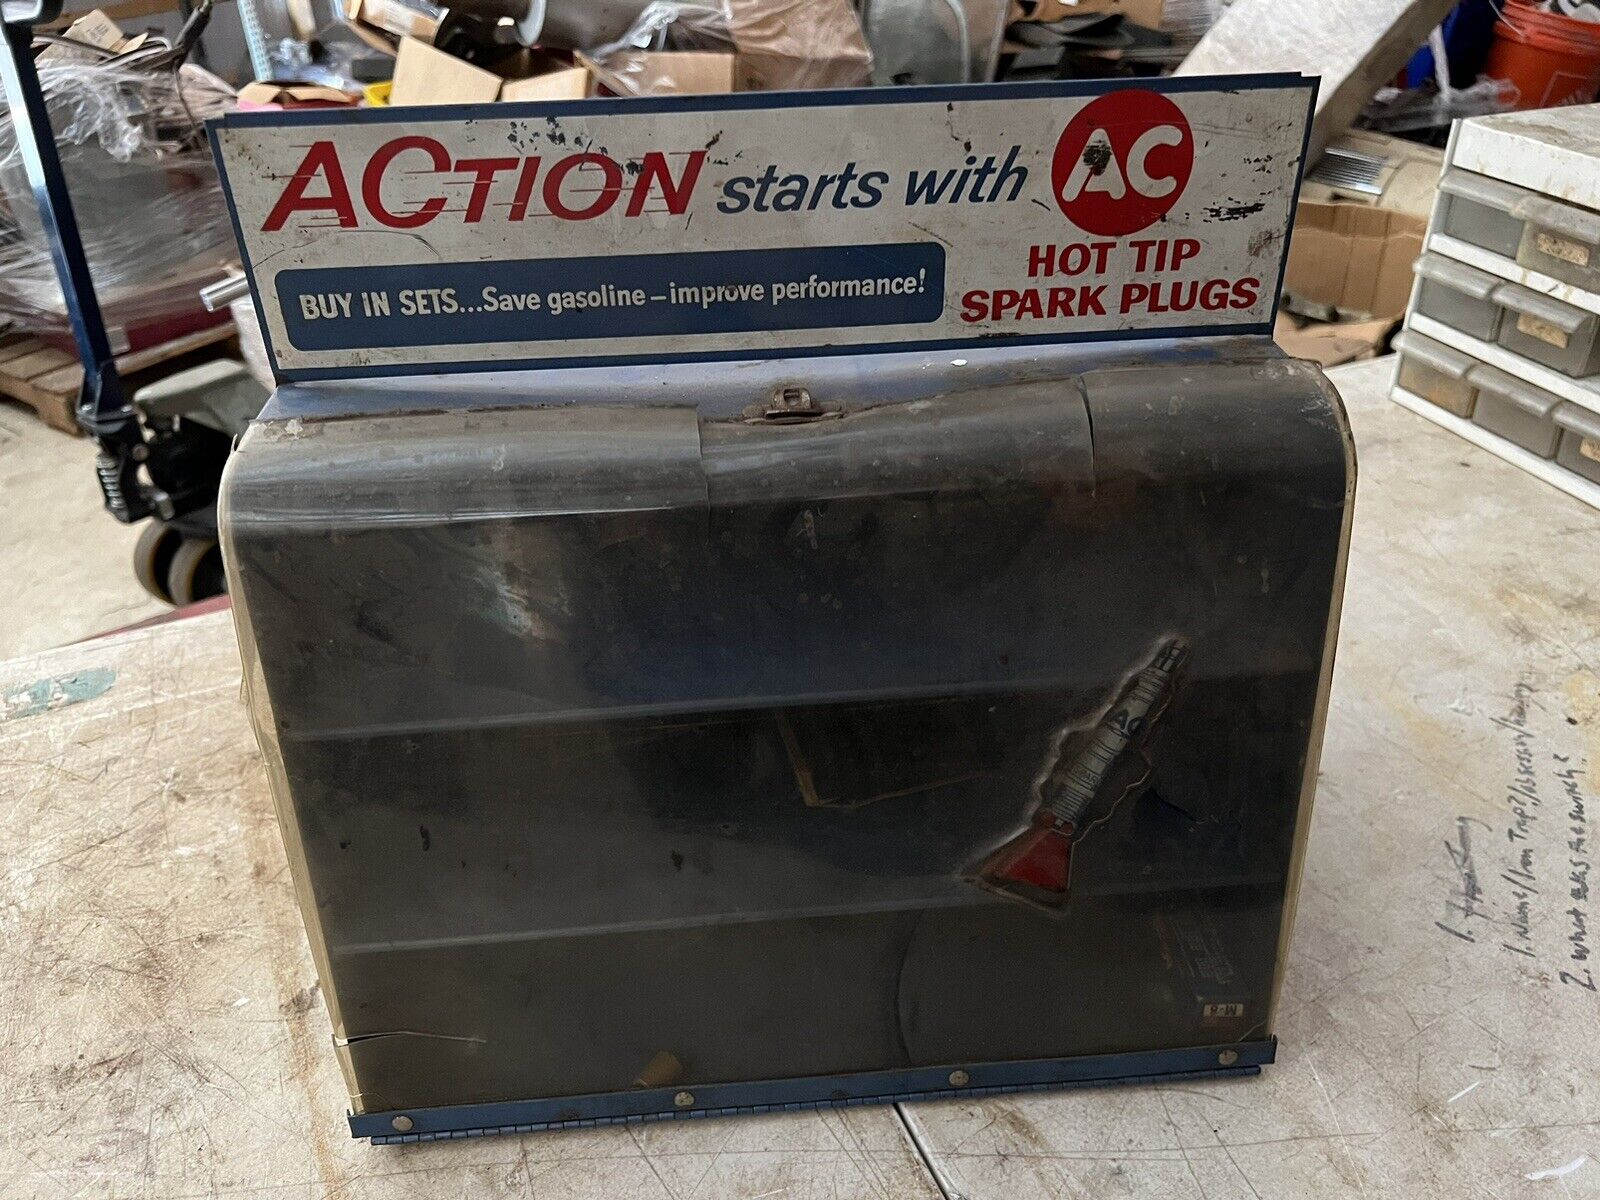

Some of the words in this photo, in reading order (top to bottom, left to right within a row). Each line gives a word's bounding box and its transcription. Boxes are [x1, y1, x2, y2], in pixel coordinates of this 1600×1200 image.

[261, 135, 707, 232] ACTION
[717, 162, 889, 214] starts
[904, 146, 1028, 206] with
[1062, 124, 1183, 203] AC
[1028, 242, 1116, 277] HOT
[1129, 239, 1201, 272] TIP
[299, 293, 352, 320] BUY
[361, 291, 391, 317] IN
[548, 283, 646, 314] gasoline
[772, 268, 926, 305] performance!
[960, 285, 1107, 323] SPARK
[1119, 277, 1260, 314] PLUGS
[1559, 968, 1597, 992] 2.
